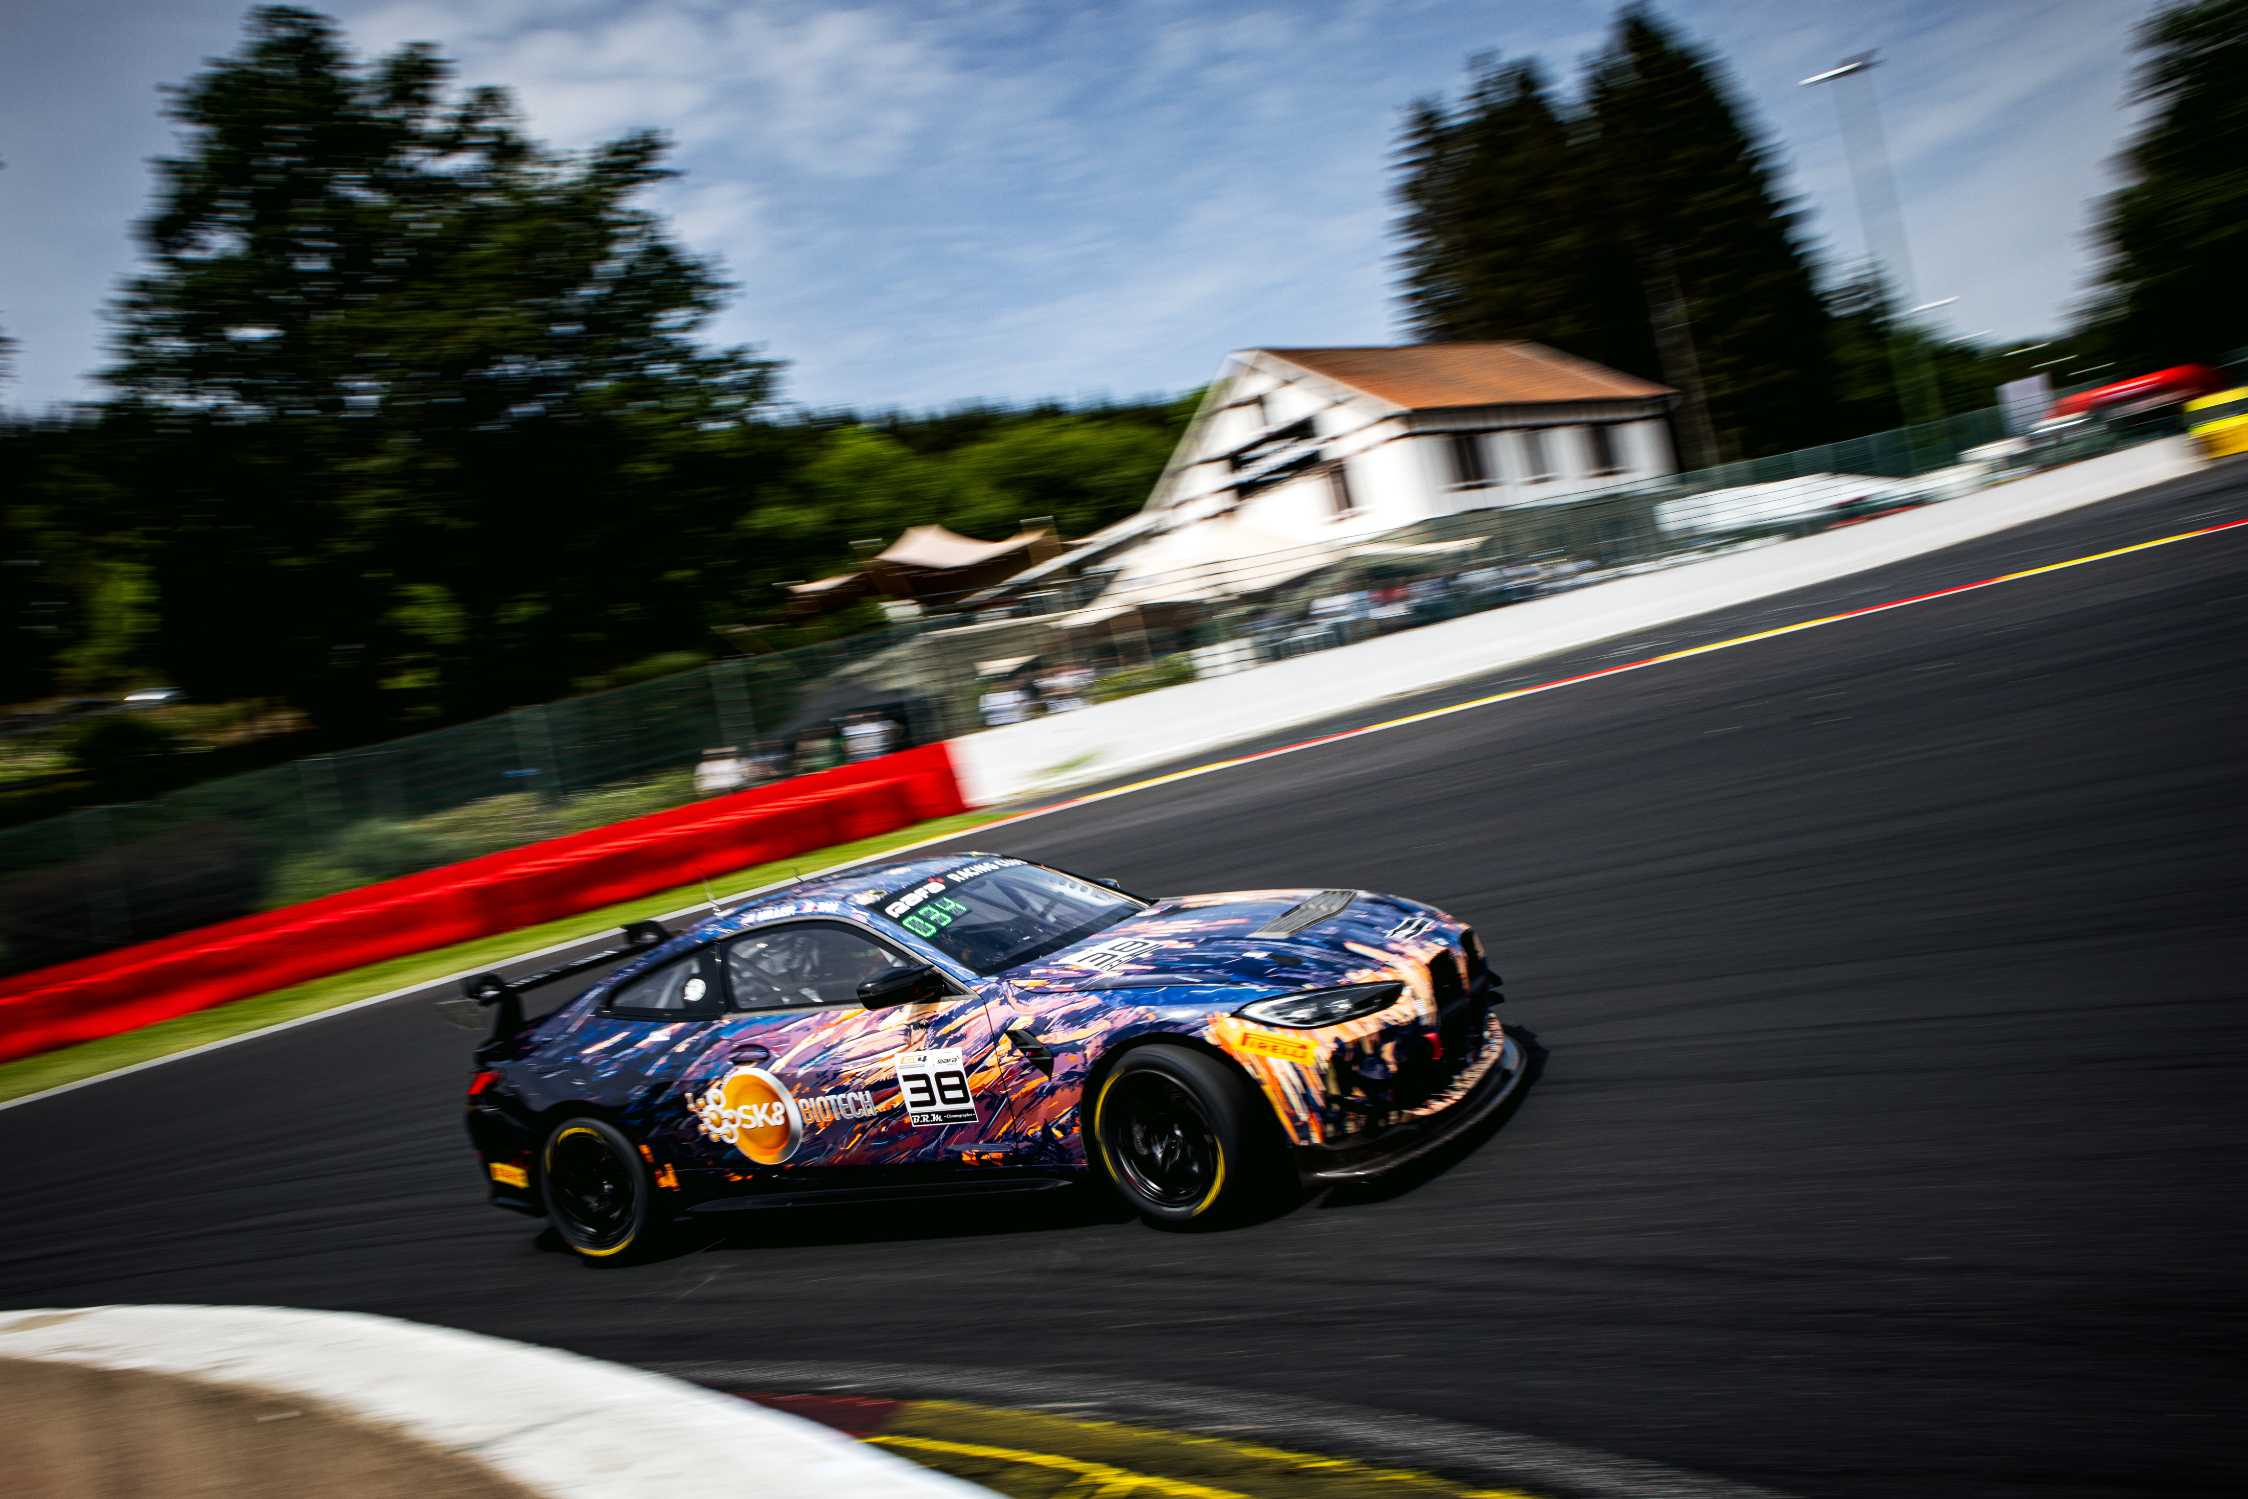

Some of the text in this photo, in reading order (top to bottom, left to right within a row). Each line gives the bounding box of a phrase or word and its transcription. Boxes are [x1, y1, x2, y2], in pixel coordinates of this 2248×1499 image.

[946, 862, 1000, 882] RACING
[902, 1070, 971, 1108] 38
[735, 1090, 877, 1129] SK8 BIOTECH
